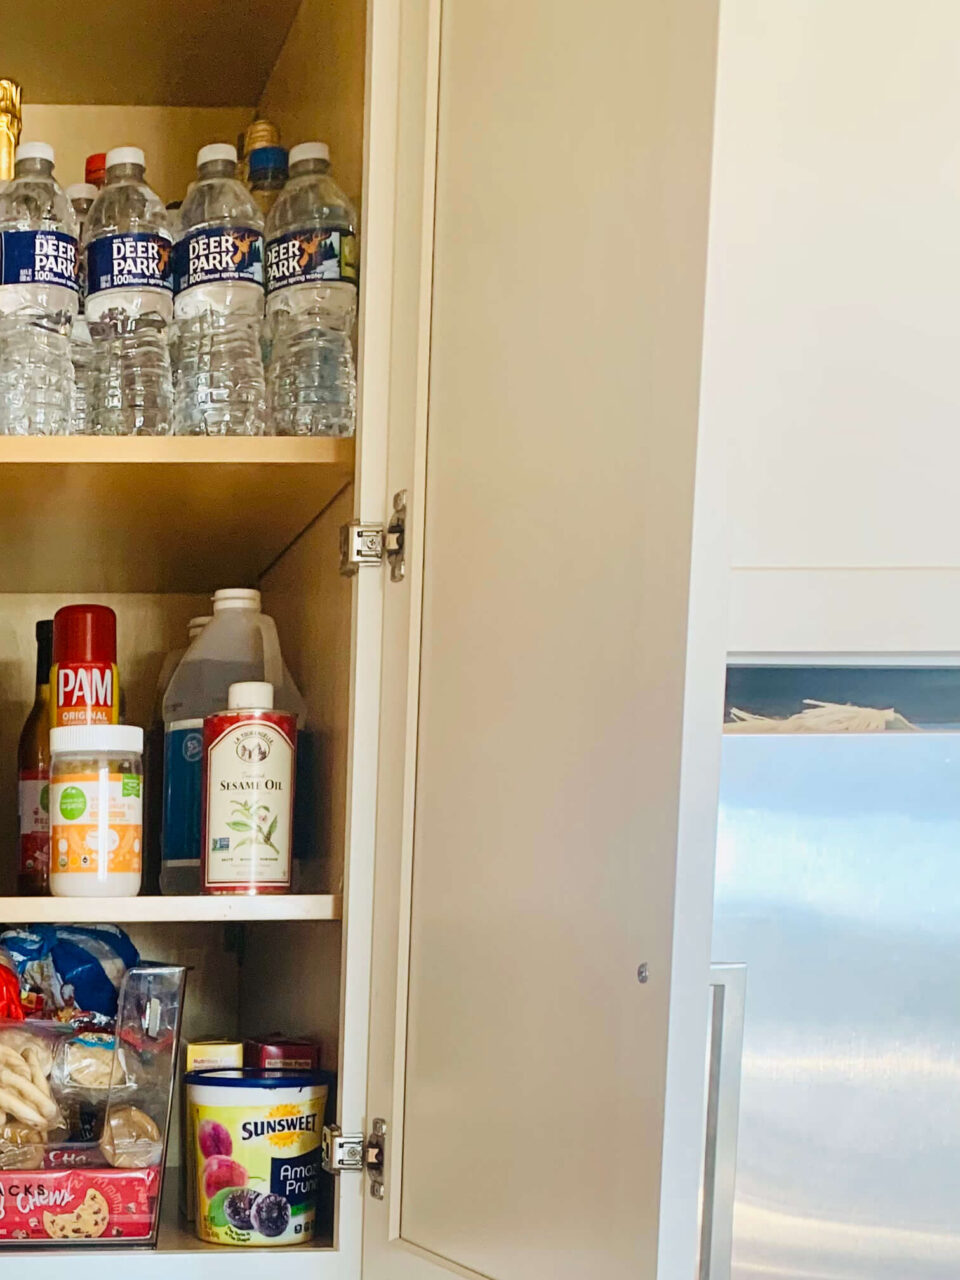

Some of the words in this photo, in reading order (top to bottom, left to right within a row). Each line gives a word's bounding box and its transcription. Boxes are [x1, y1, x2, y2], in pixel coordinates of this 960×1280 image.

[34, 239, 76, 261] DEER
[112, 241, 158, 259] DEER
[190, 236, 234, 259] DEER
[34, 256, 76, 277] PARK
[113, 258, 159, 276] PARK
[190, 252, 234, 274] PARK
[58, 668, 112, 707] PAM
[220, 780, 260, 791] SESAME
[264, 779, 284, 791] OIL
[242, 1113, 317, 1141] SUNSWEET
